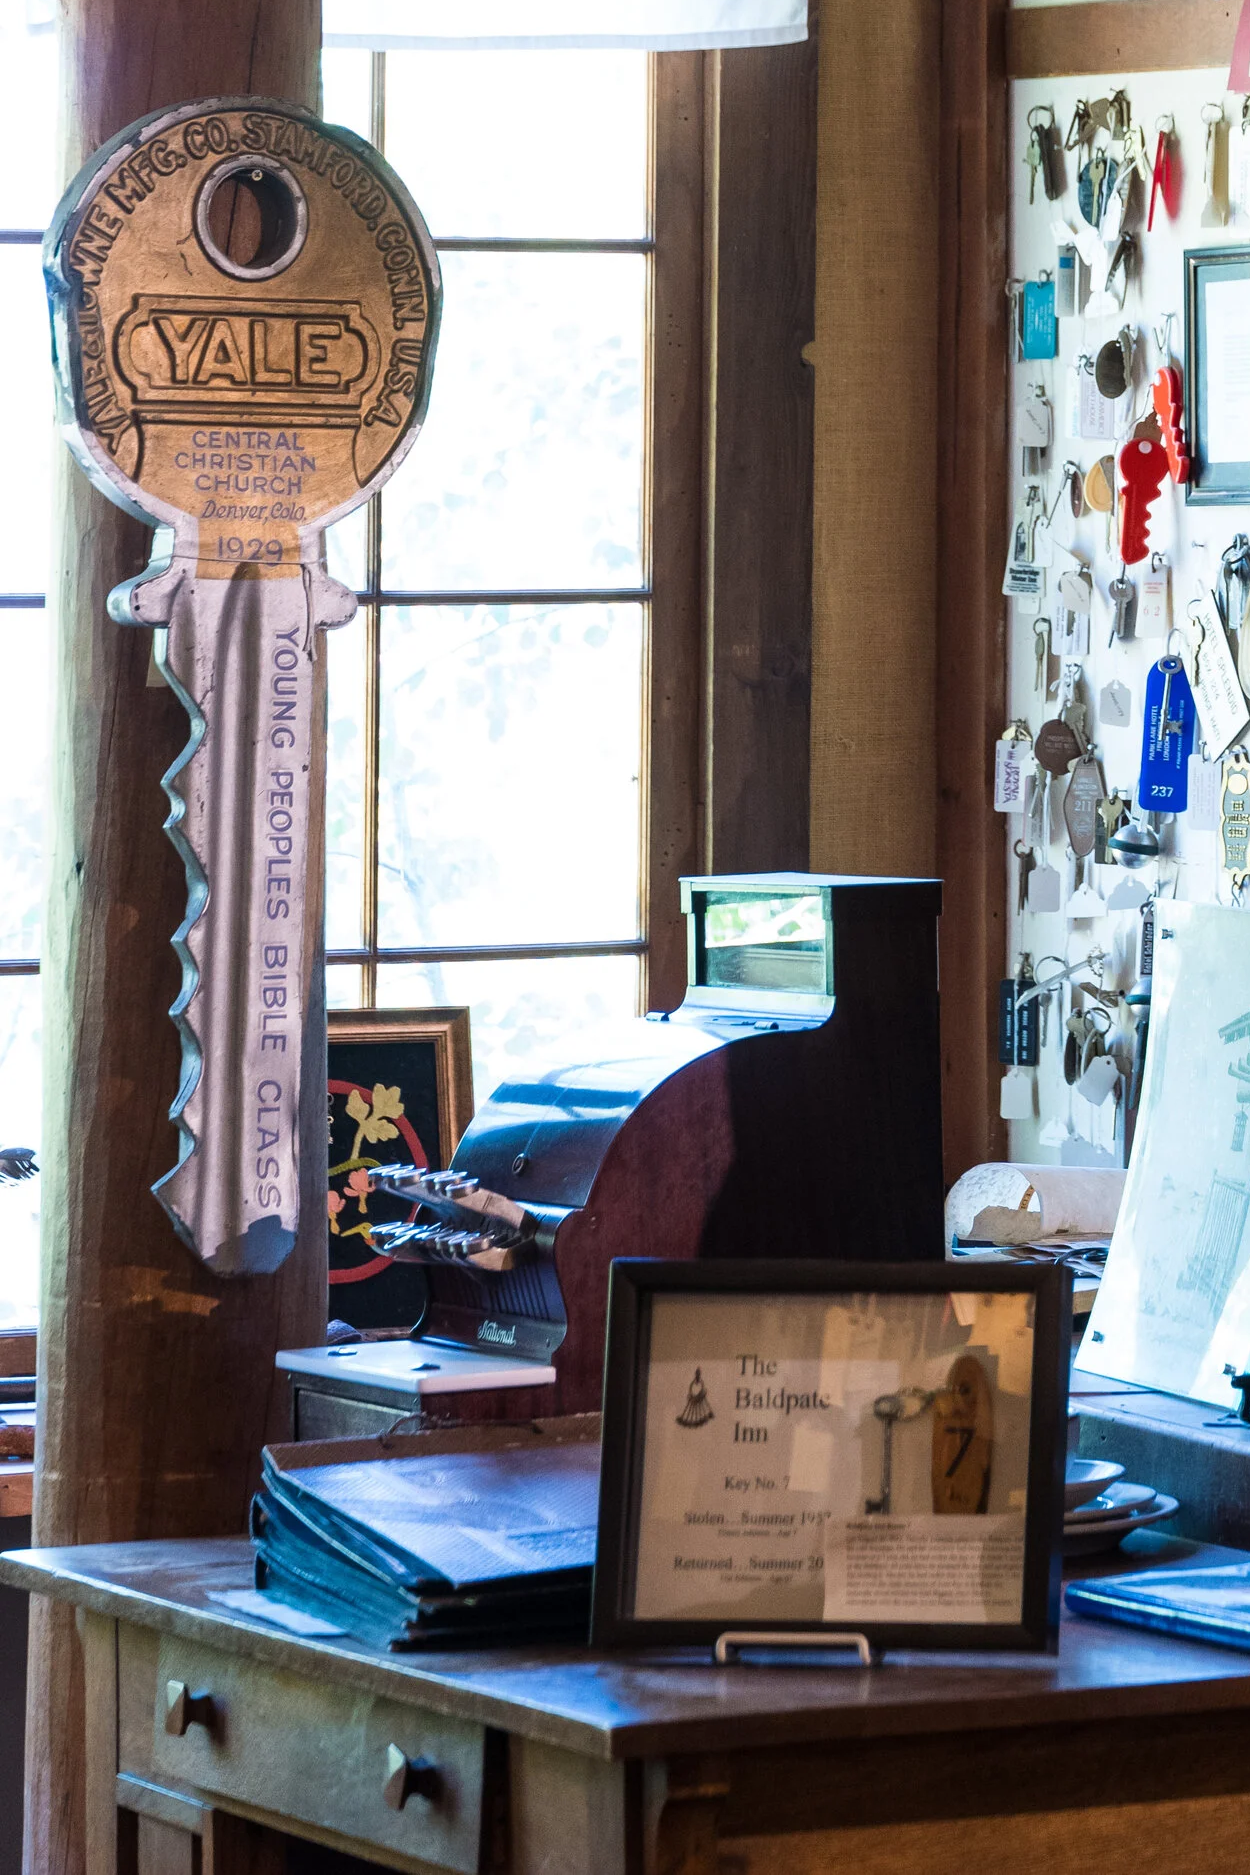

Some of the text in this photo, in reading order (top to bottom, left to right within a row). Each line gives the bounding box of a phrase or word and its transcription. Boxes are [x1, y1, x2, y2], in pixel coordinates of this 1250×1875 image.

[183, 116, 239, 161] CO.
[152, 315, 343, 389] YALE
[192, 429, 306, 452] CENTRAL
[174, 451, 317, 473] CHRISTIAN
[195, 474, 303, 496] CHURCH
[216, 534, 284, 568] 1929
[1203, 613, 1237, 716] HOTEL SPLENDID
[1151, 705, 1159, 725] HOTEL
[1002, 761, 1012, 804] SONESTA
[1151, 785, 1175, 798] 237
[1074, 800, 1092, 812] 211
[254, 625, 301, 1210] YOUNG PEOPLES BIBLE CLASS
[736, 1354, 777, 1377] The
[735, 1386, 830, 1415] Baldpate
[732, 1421, 769, 1444] Inn
[945, 1426, 976, 1478] 7
[724, 1475, 752, 1496] Key
[755, 1476, 778, 1490] No.
